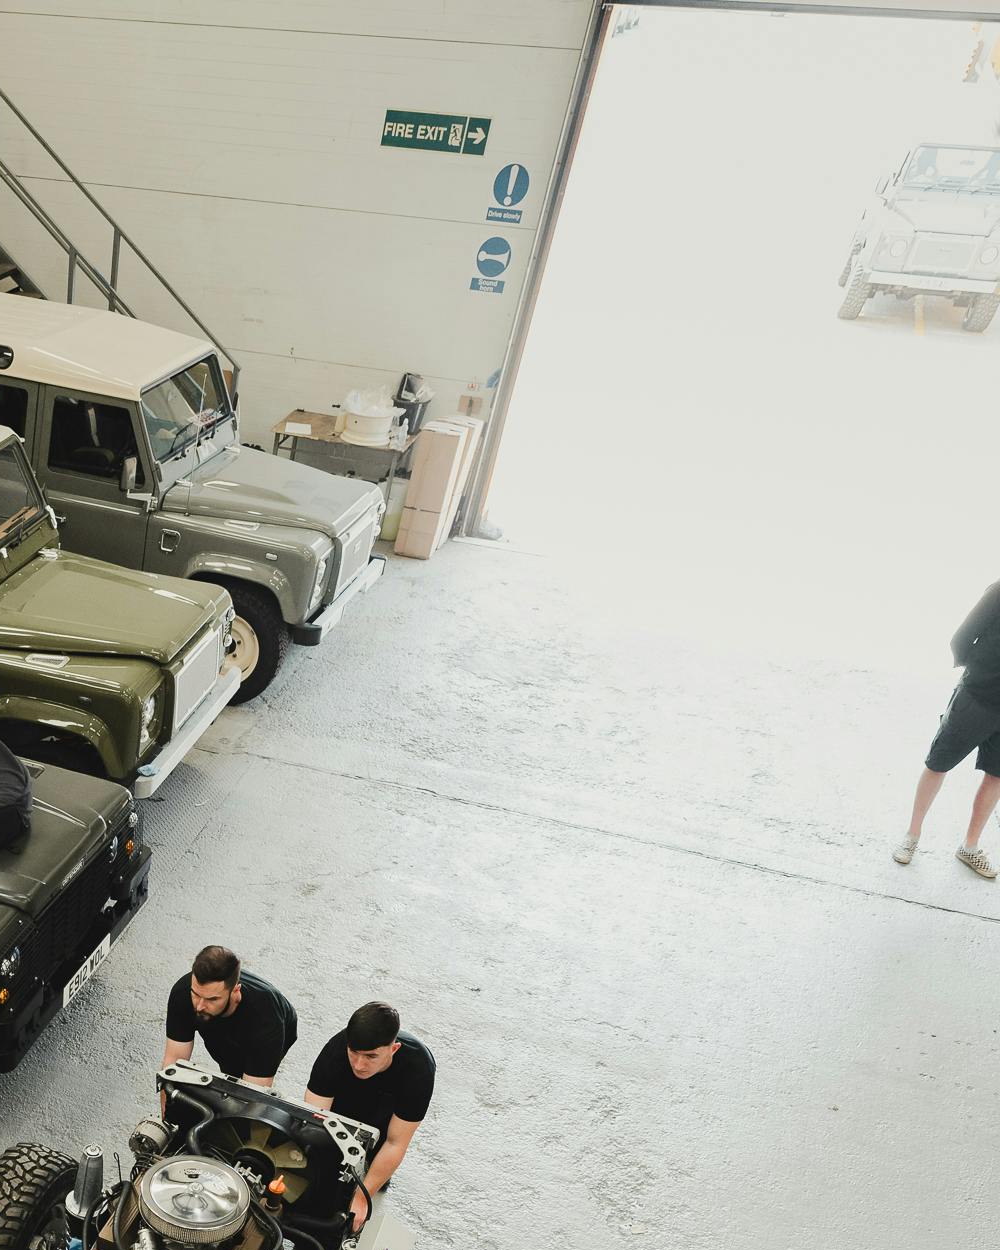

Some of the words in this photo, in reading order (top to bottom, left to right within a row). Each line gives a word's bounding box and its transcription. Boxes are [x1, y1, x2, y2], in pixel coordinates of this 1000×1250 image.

[383, 122, 414, 139] FIRE
[416, 124, 447, 141] EXIT
[478, 278, 498, 287] Sound
